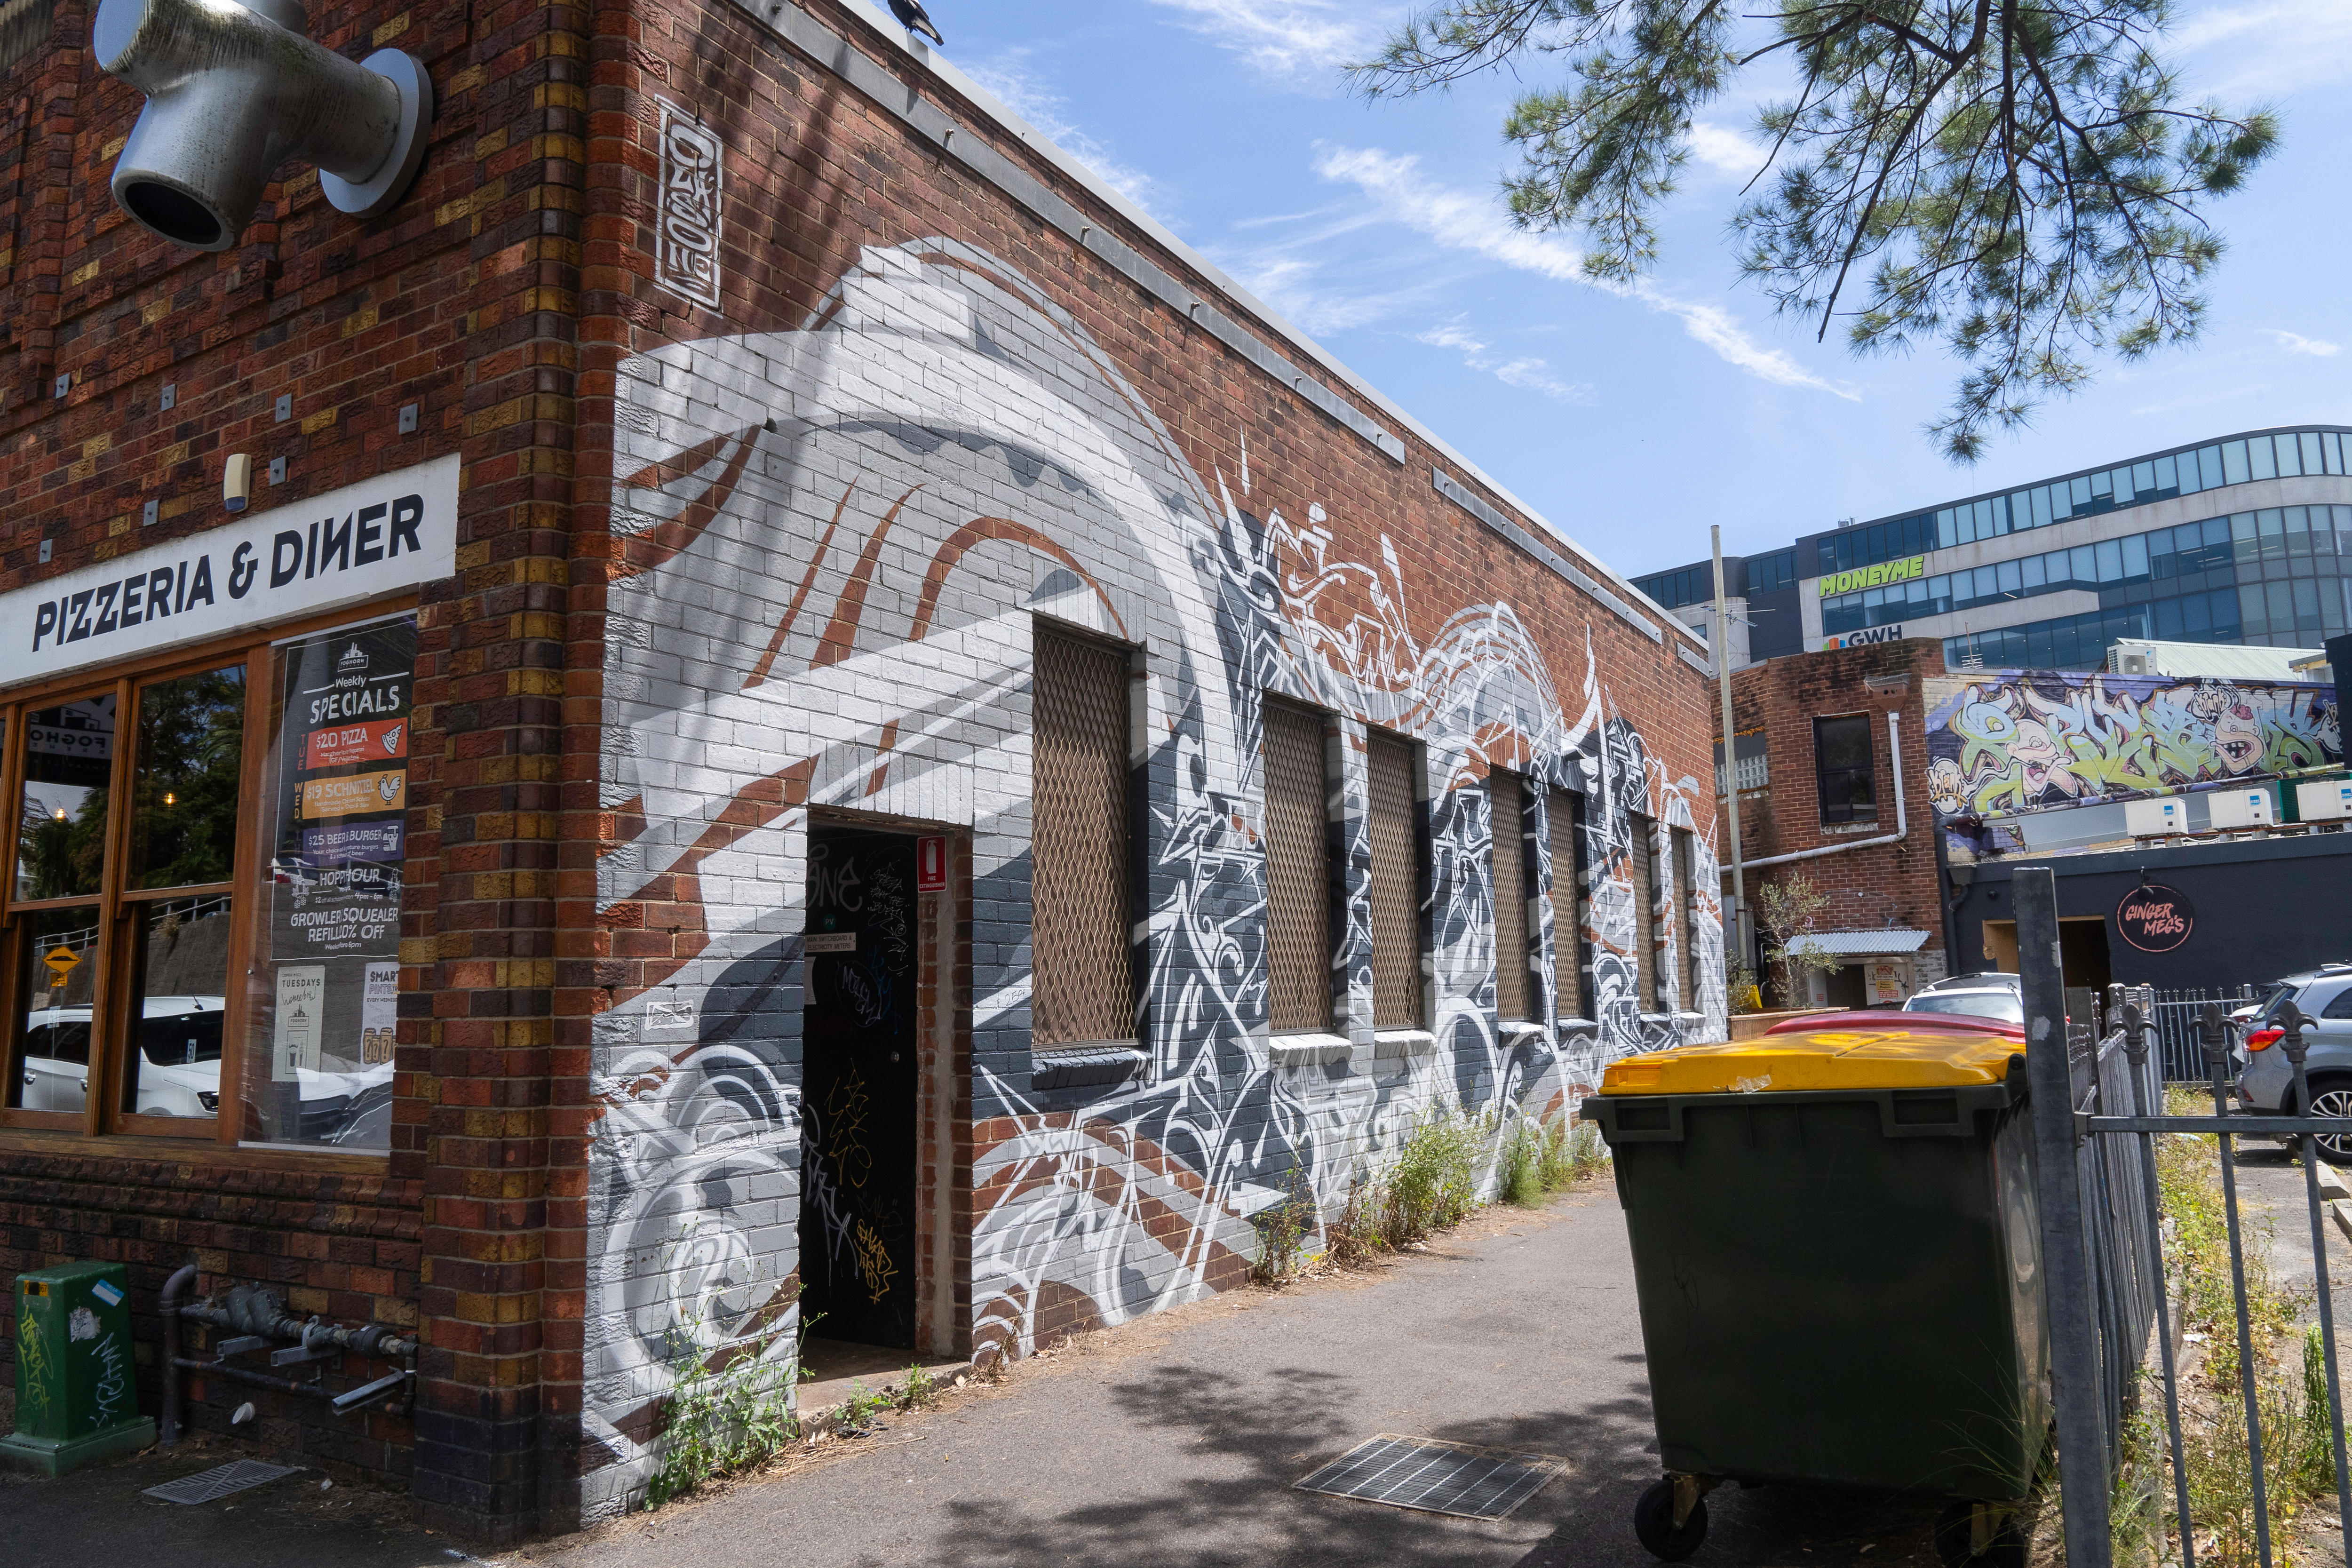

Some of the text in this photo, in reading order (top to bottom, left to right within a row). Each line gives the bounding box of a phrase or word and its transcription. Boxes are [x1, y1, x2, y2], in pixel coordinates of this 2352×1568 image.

[1820, 556, 1924, 597] MONEYME
[32, 555, 215, 652] PIZZERIA
[228, 541, 259, 599] &
[1848, 624, 1903, 647] GWH
[336, 675, 366, 688] Weekly
[310, 685, 399, 724] SPECIALS
[316, 728, 368, 749] $20 PIZZA
[307, 785, 322, 800] $19
[308, 835, 325, 846] $25
[327, 834, 346, 845] BEER
[350, 829, 382, 841] BURGER
[346, 868, 380, 883] HOUR
[354, 891, 369, 901] 4pm
[373, 892, 383, 901] 6pm
[291, 907, 399, 926] GROWLER SQUEALER
[2125, 902, 2174, 921] GINGER
[361, 925, 385, 939] OFF
[2144, 915, 2184, 936] MEG'S
[283, 979, 320, 987] TUESDAYS
